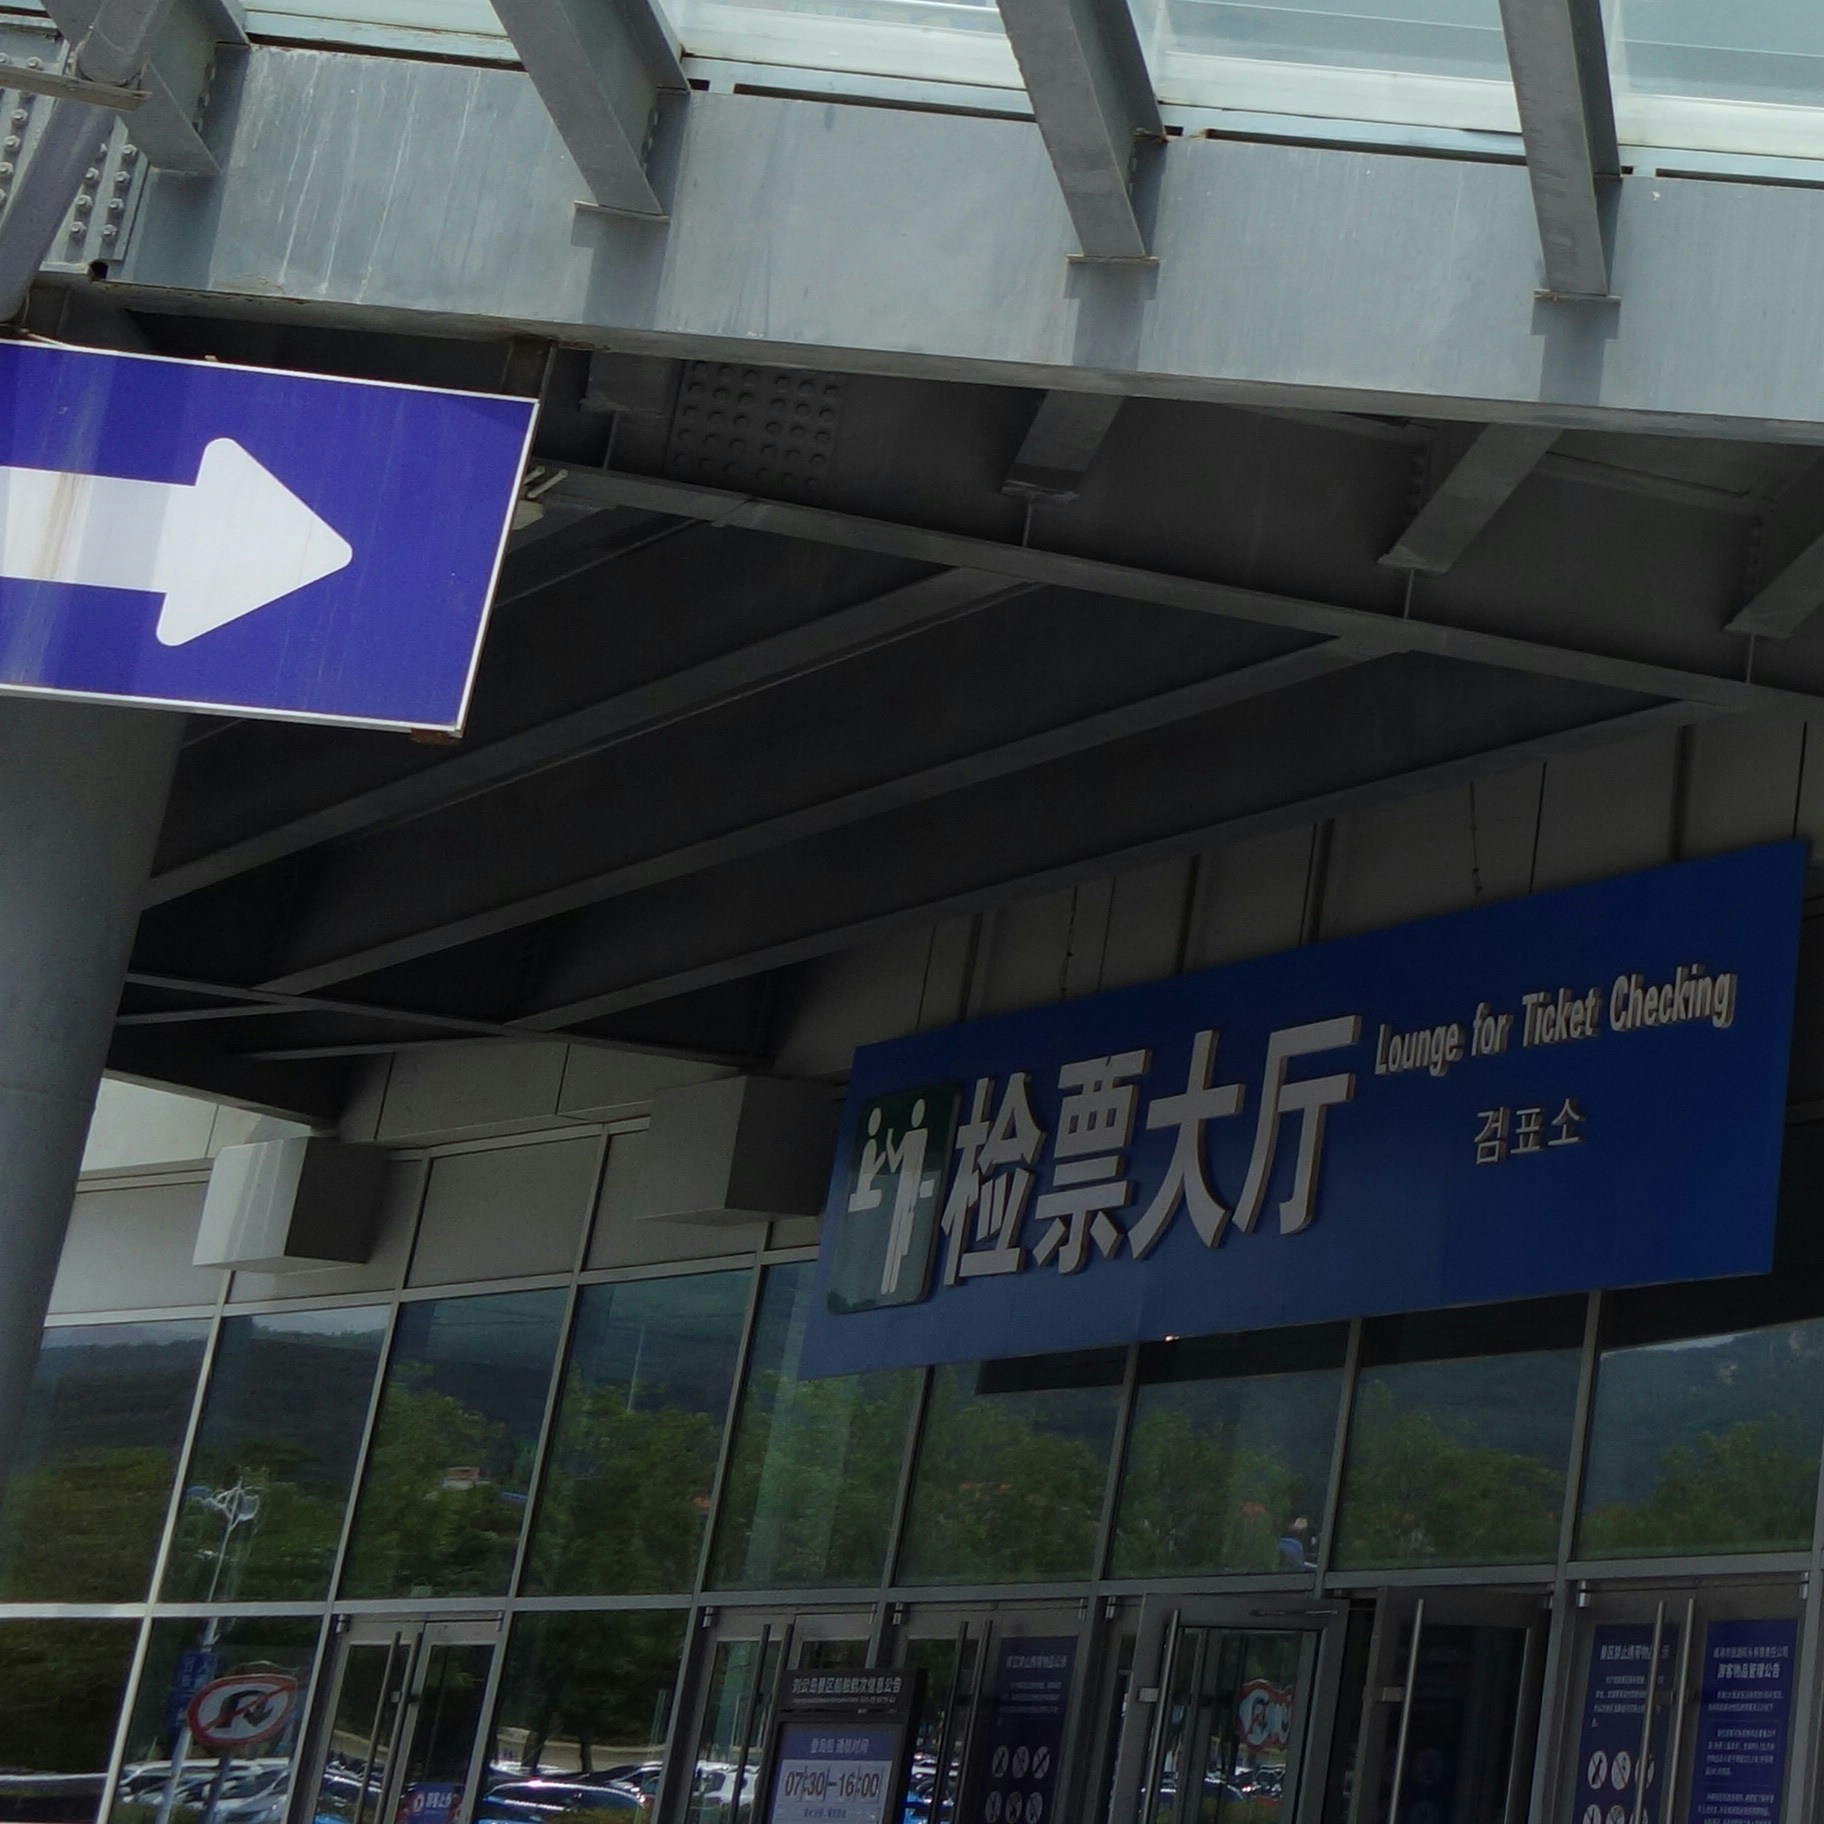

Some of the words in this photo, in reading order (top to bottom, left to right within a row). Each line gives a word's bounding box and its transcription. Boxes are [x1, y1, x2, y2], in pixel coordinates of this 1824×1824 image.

[1376, 1021, 1462, 1078] Lounge
[1470, 1002, 1511, 1057] for
[1521, 989, 1598, 1043] Ticket
[1608, 963, 1738, 1035] Checking
[942, 1014, 1363, 1288] 检票大厅
[1474, 1096, 1586, 1166] 검표소
